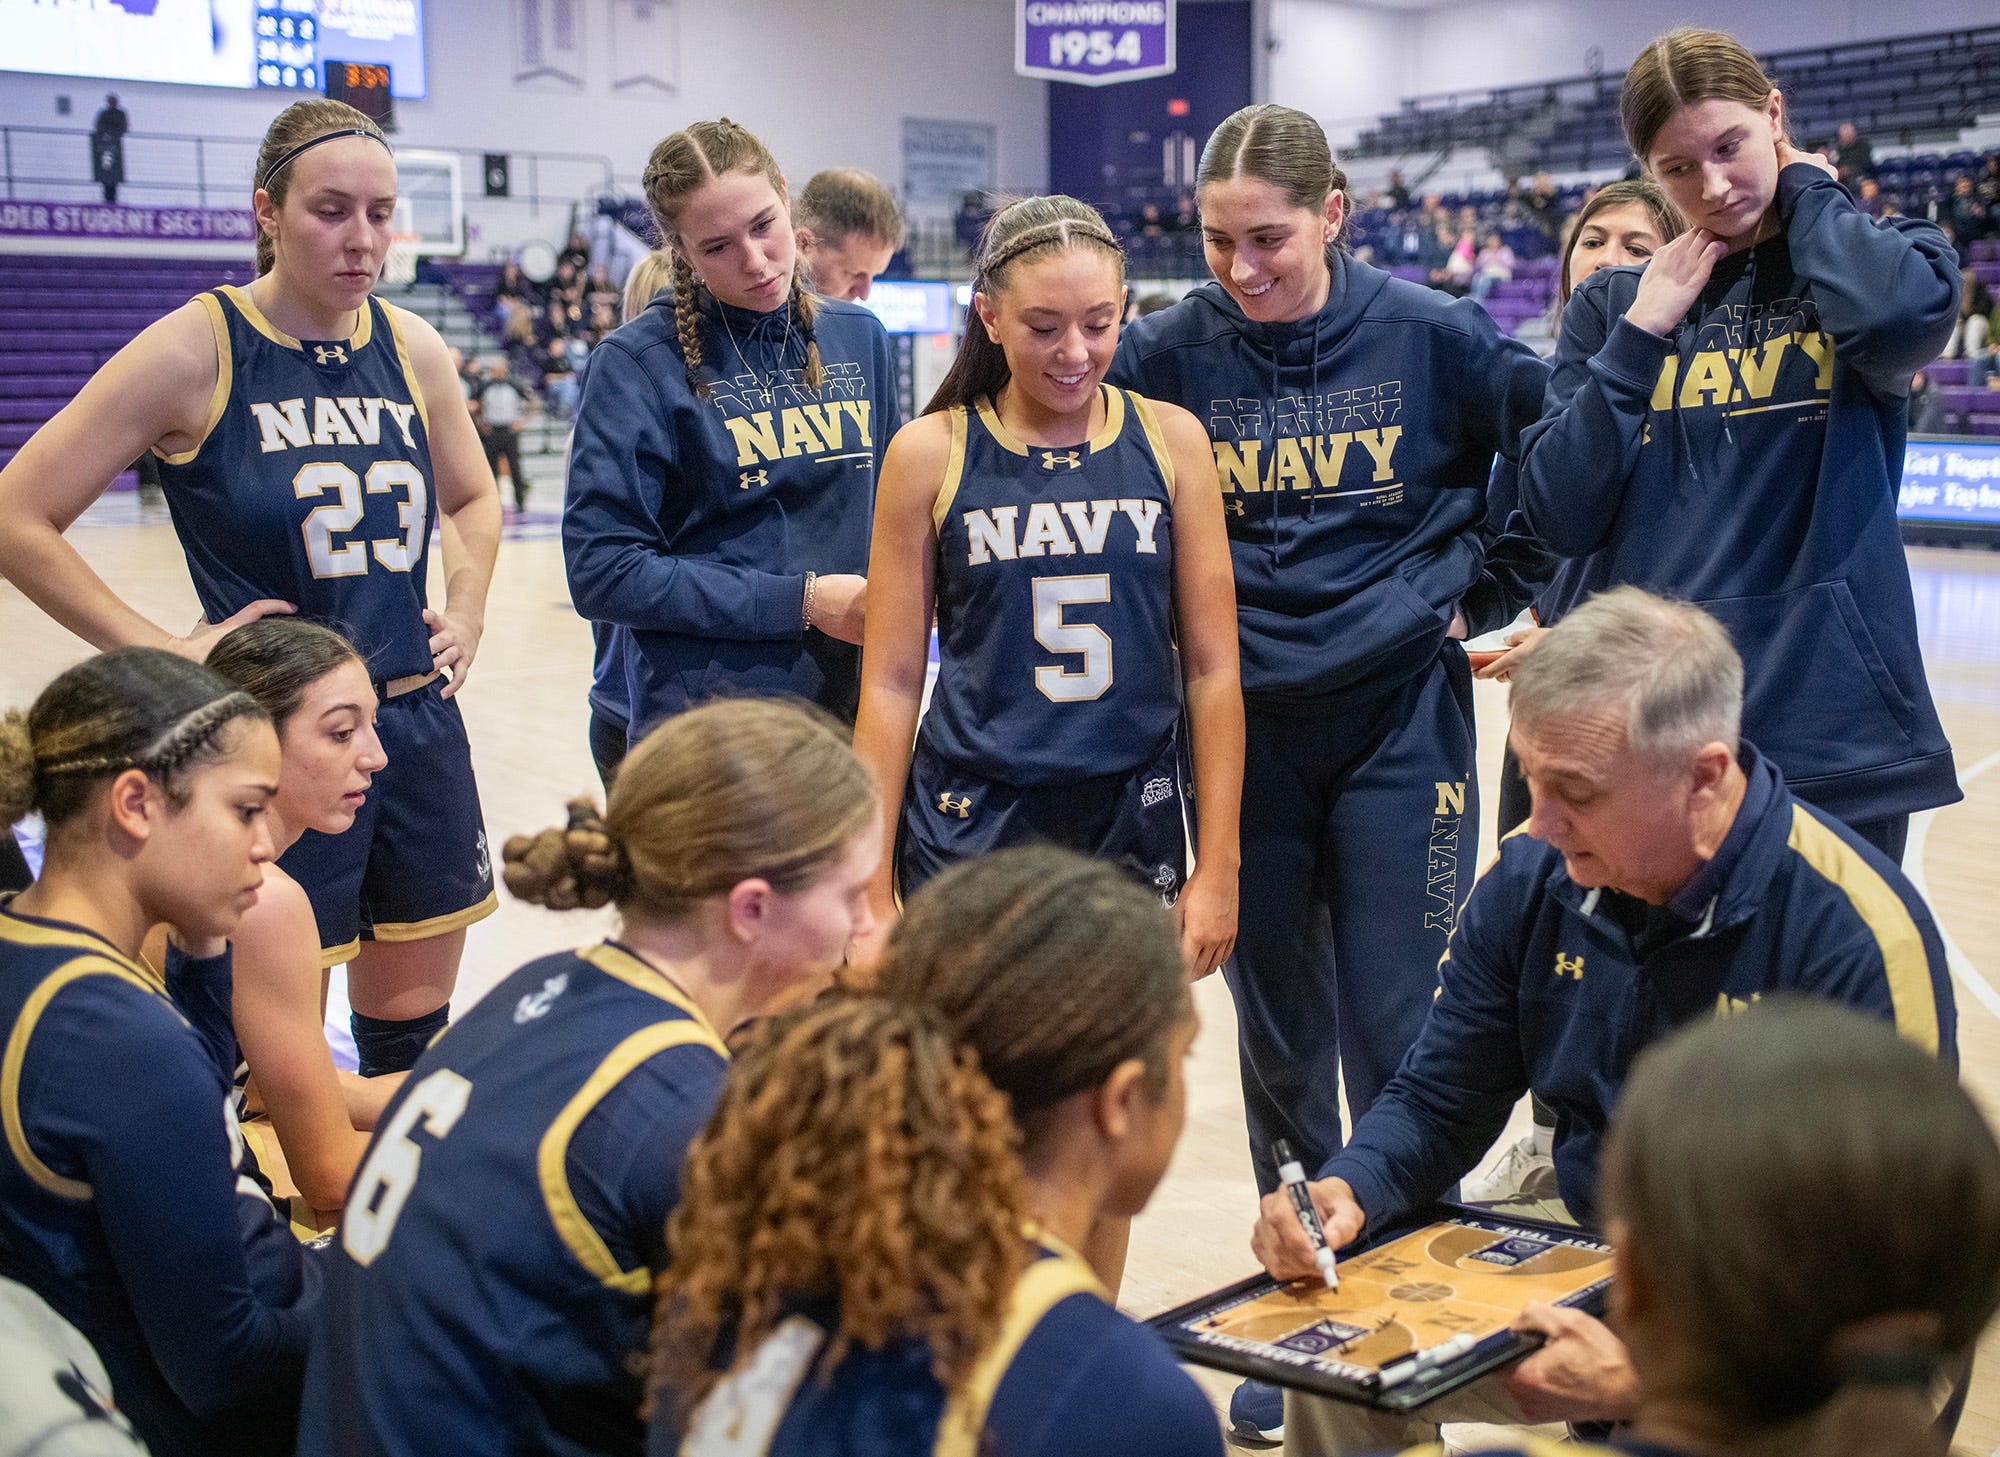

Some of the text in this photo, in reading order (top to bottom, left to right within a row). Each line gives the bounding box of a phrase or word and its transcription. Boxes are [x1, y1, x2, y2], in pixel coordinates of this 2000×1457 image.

[1027, 2, 1166, 26] CHAMPIONS
[1049, 30, 1141, 66] 1954
[0, 204, 250, 237] DER STUDENT SECTION
[252, 397, 417, 453] NAVY
[724, 400, 873, 467] NAVY
[1212, 425, 1403, 493] NAVY
[292, 461, 427, 580] 23
[963, 499, 1162, 566] NAVY
[1031, 573, 1113, 703] 5
[1435, 781, 1466, 815] N
[1424, 818, 1461, 935] NAVY
[342, 1067, 473, 1268] 6
[1496, 1226, 1550, 1241] NAVAL
[1560, 1238, 1612, 1251] ACAD
